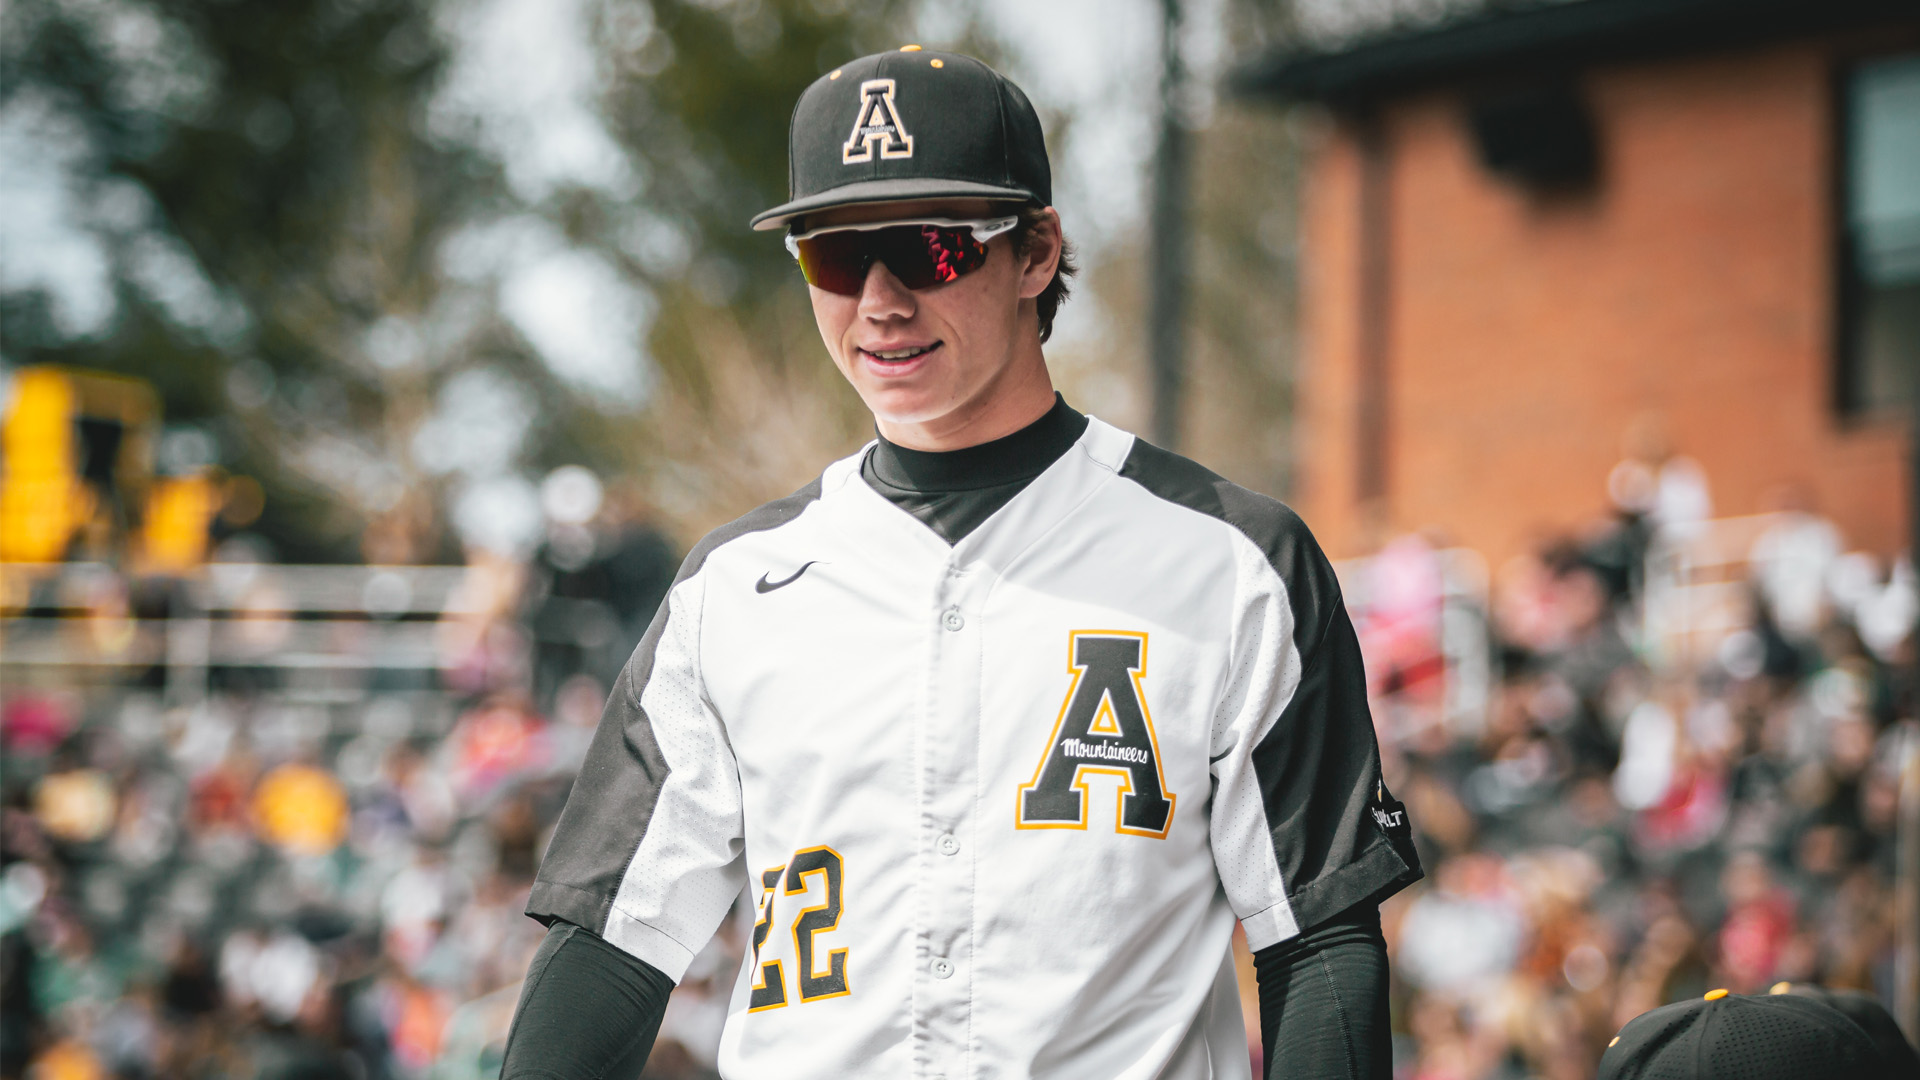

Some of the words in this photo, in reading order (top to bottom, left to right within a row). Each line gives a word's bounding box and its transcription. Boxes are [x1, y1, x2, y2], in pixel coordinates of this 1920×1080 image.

[843, 79, 914, 165] A
[1015, 629, 1177, 840] A
[1060, 738, 1148, 764] Mountaineers
